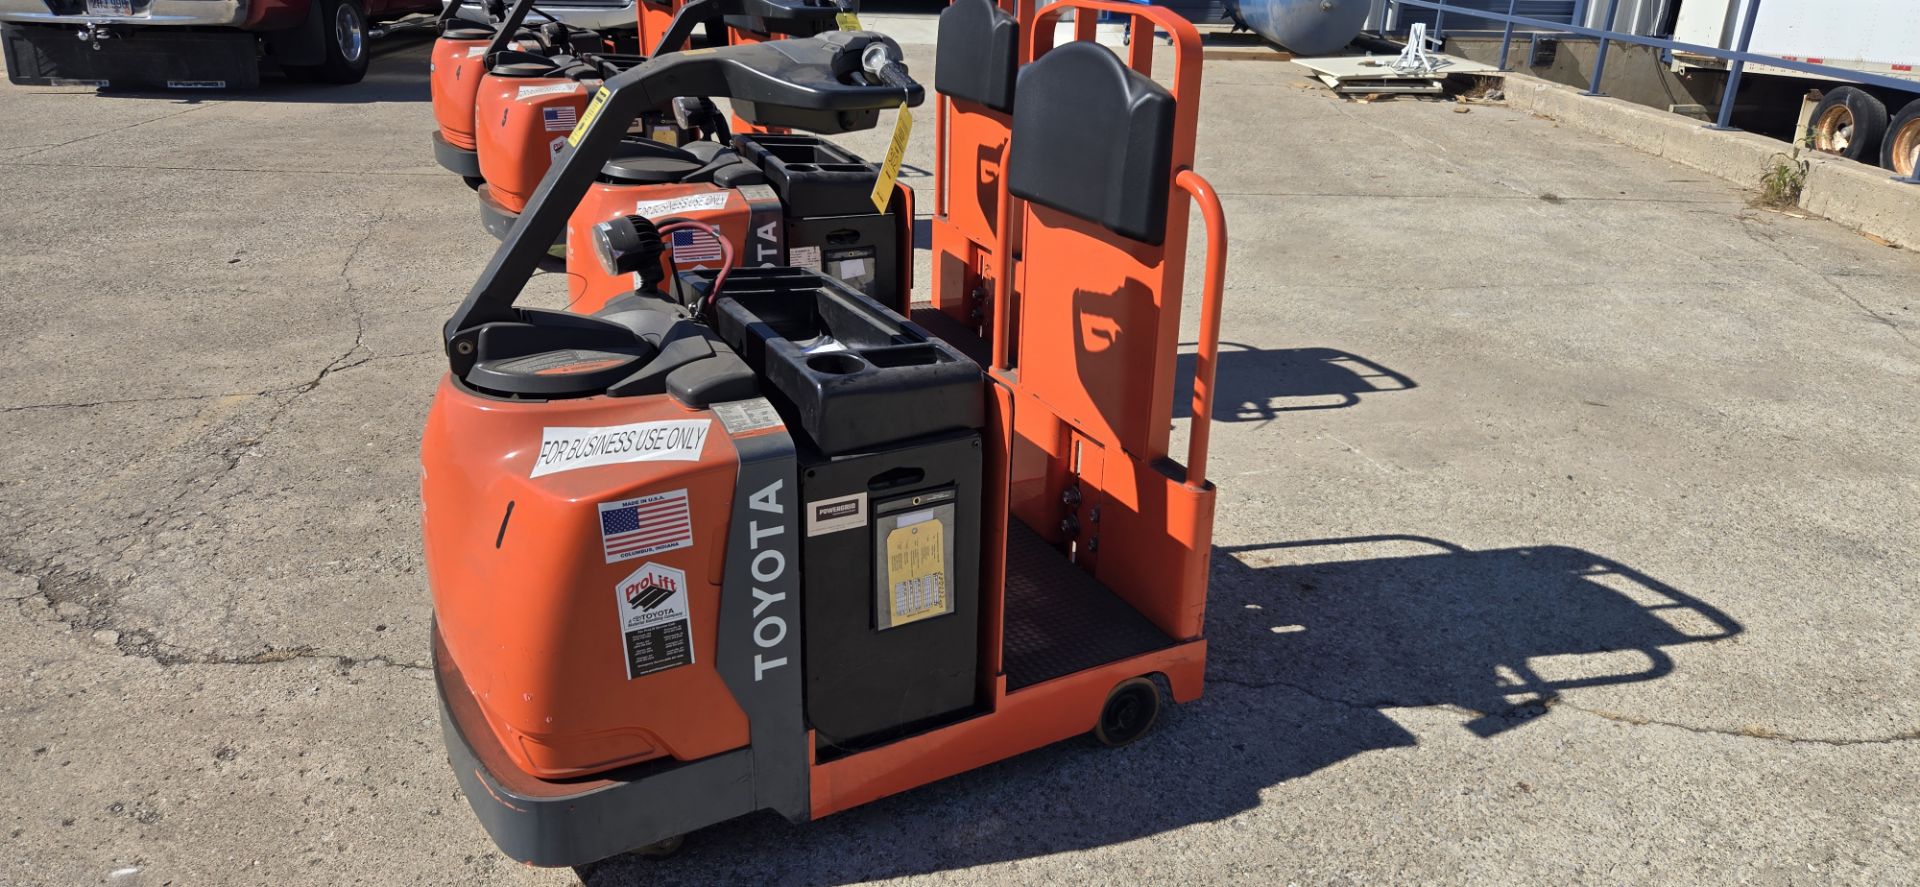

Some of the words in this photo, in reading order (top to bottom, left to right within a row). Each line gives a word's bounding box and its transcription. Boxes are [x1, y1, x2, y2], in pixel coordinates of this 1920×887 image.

[501, 108, 508, 127] 3
[538, 440, 567, 466] FOR
[566, 430, 634, 460] BUSINESS
[635, 428, 665, 450] USE
[666, 426, 707, 450] ONLY
[622, 499, 639, 507] MADE
[648, 495, 665, 503] U.S.A.
[620, 547, 655, 558] COLUMBUS,
[655, 542, 680, 551] INDIANA
[625, 571, 677, 603] ProLift
[749, 478, 788, 682] TOYOTA
[641, 607, 675, 620] TOYOTA
